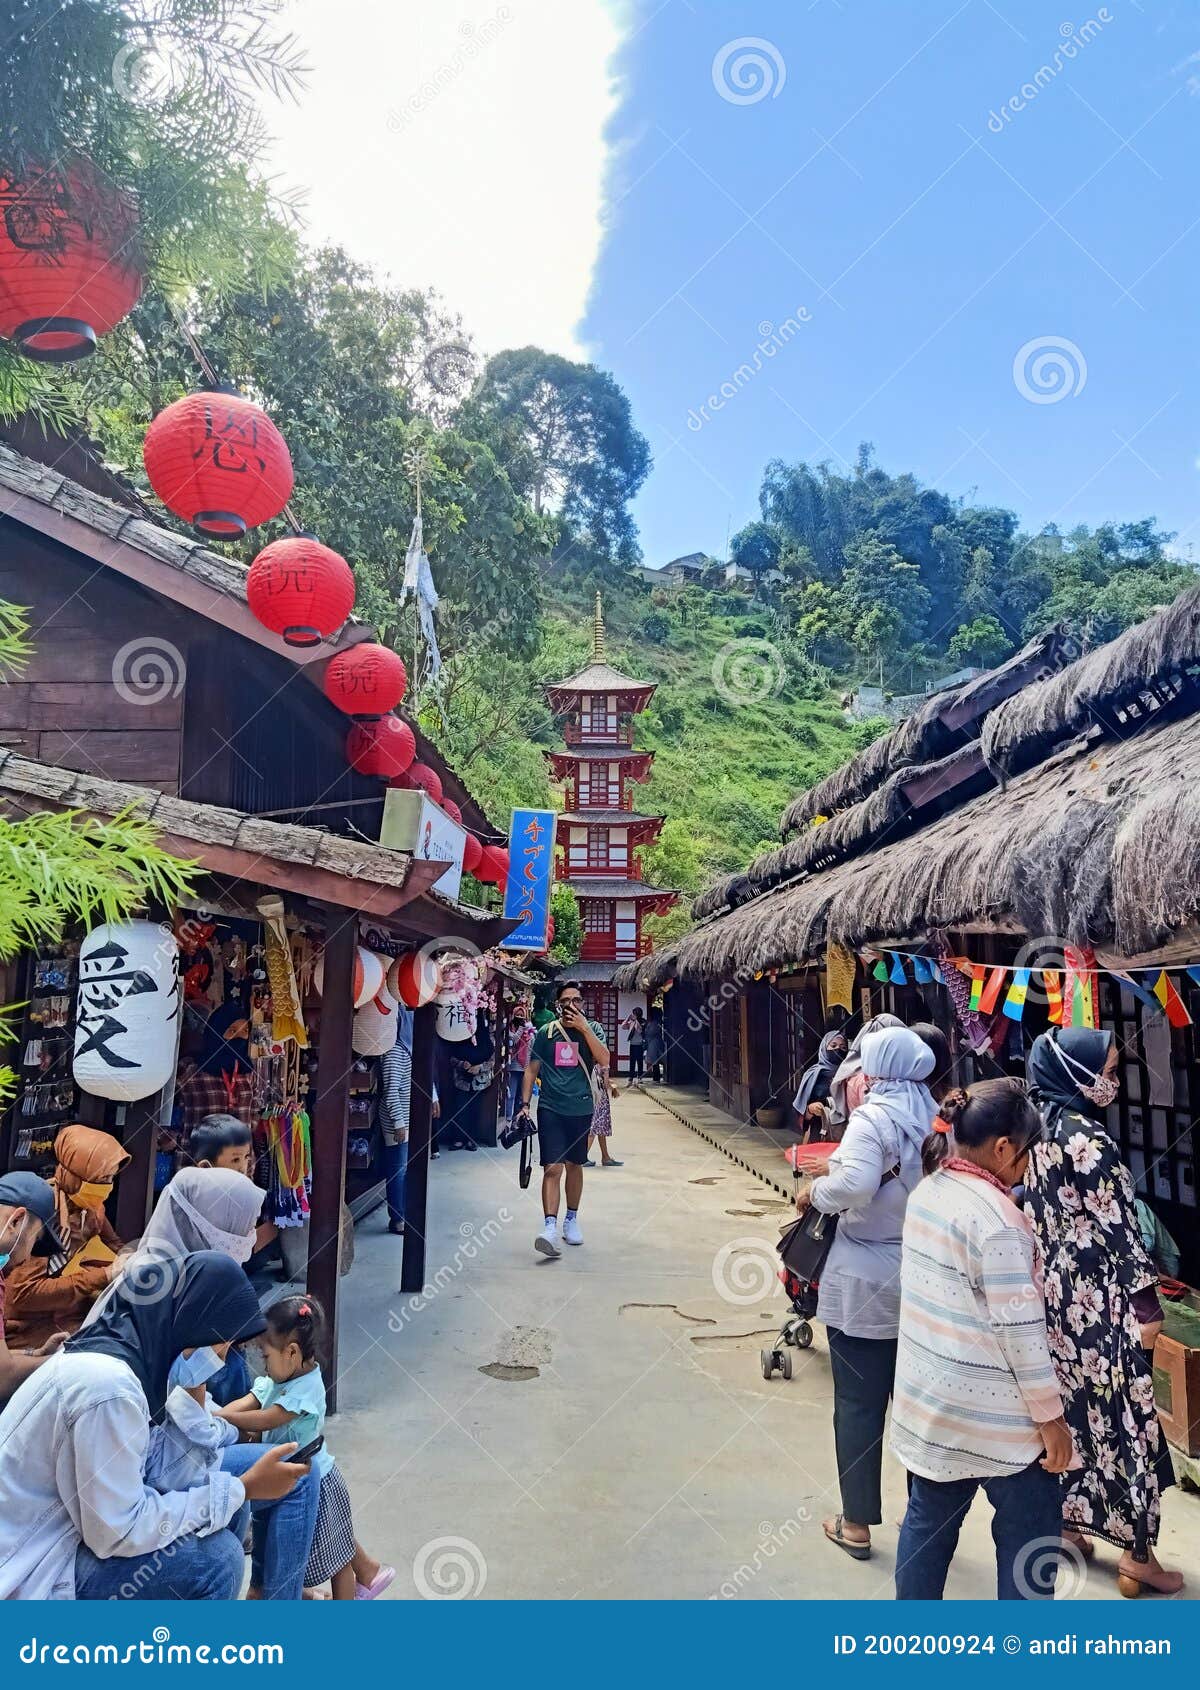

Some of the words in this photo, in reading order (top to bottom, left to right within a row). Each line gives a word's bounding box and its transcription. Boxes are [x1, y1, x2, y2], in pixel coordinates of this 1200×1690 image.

[519, 816, 545, 926] 手づくりの
[74, 941, 158, 1068] 愛
[445, 1001, 471, 1032] 福
